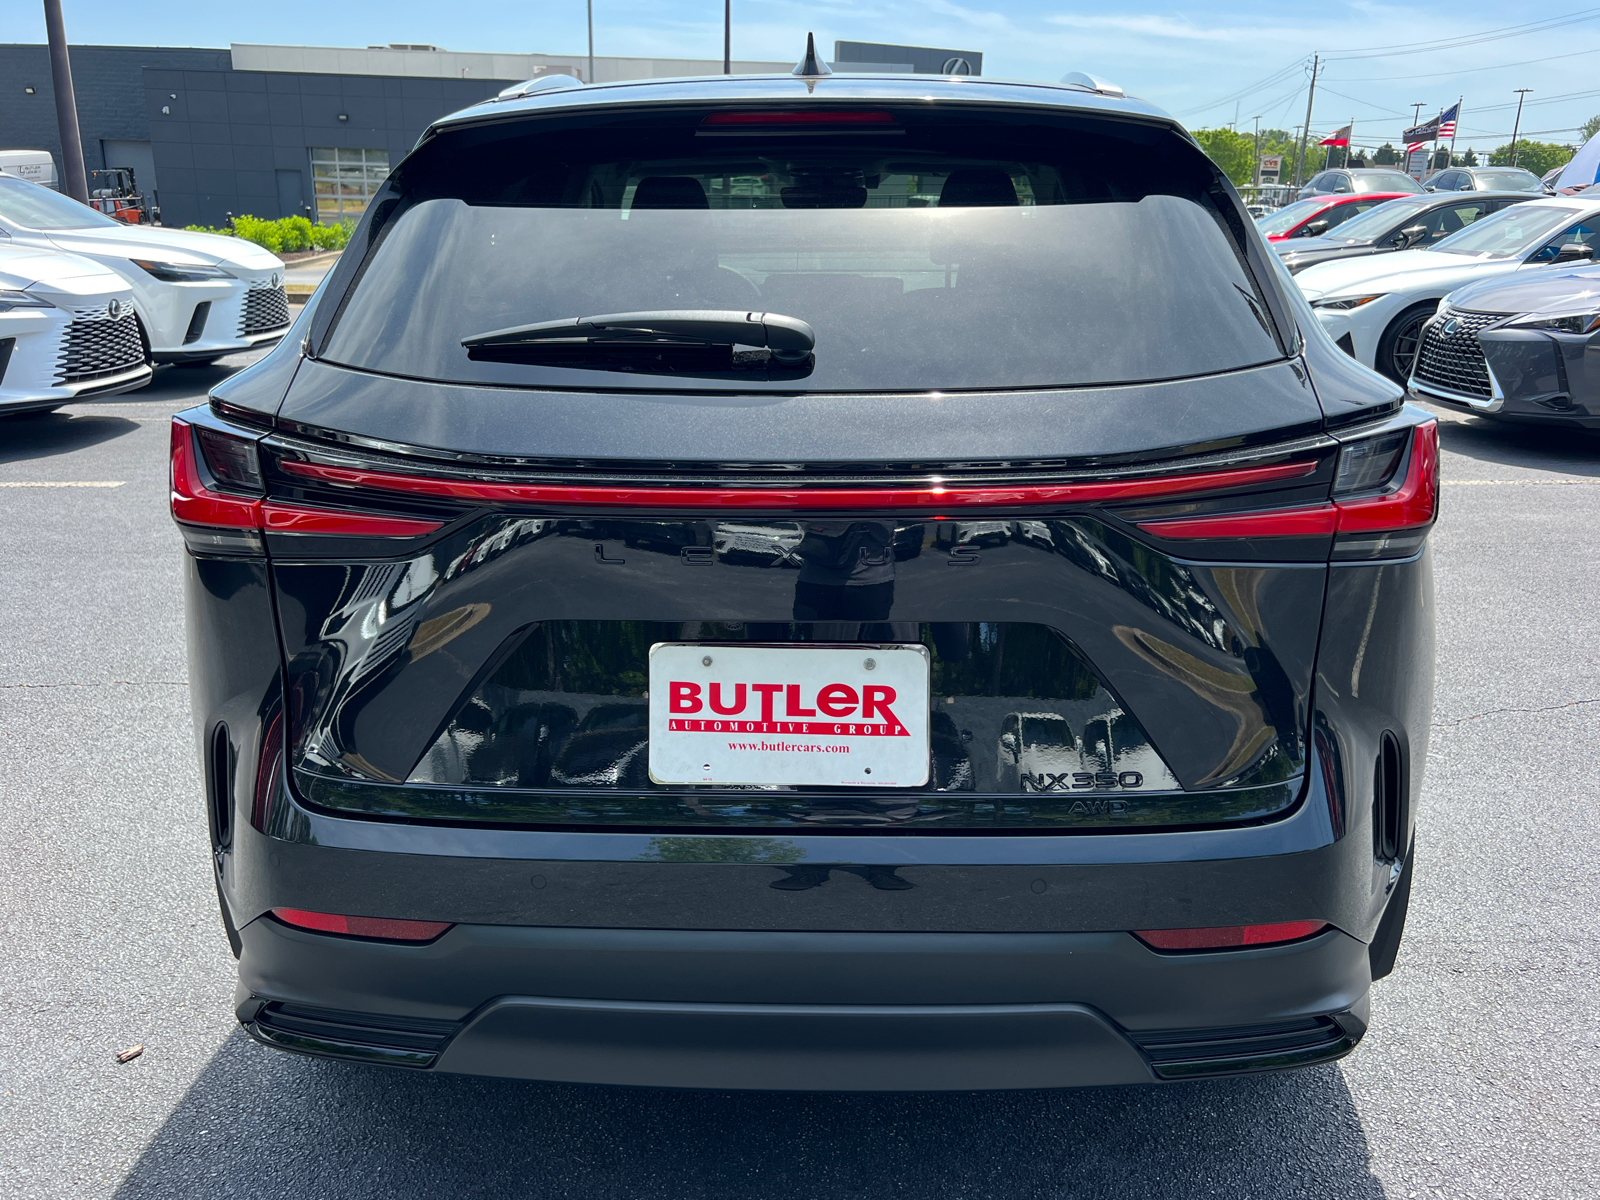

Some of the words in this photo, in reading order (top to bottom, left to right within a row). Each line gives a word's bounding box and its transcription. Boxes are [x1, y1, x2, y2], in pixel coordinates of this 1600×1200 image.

[594, 543, 982, 567] LEXUS
[670, 720, 809, 733] AUTOMOTIVE
[834, 724, 901, 735] GROUP
[728, 741, 850, 753] www.butlercars.com
[1068, 800, 1129, 816] AWD
